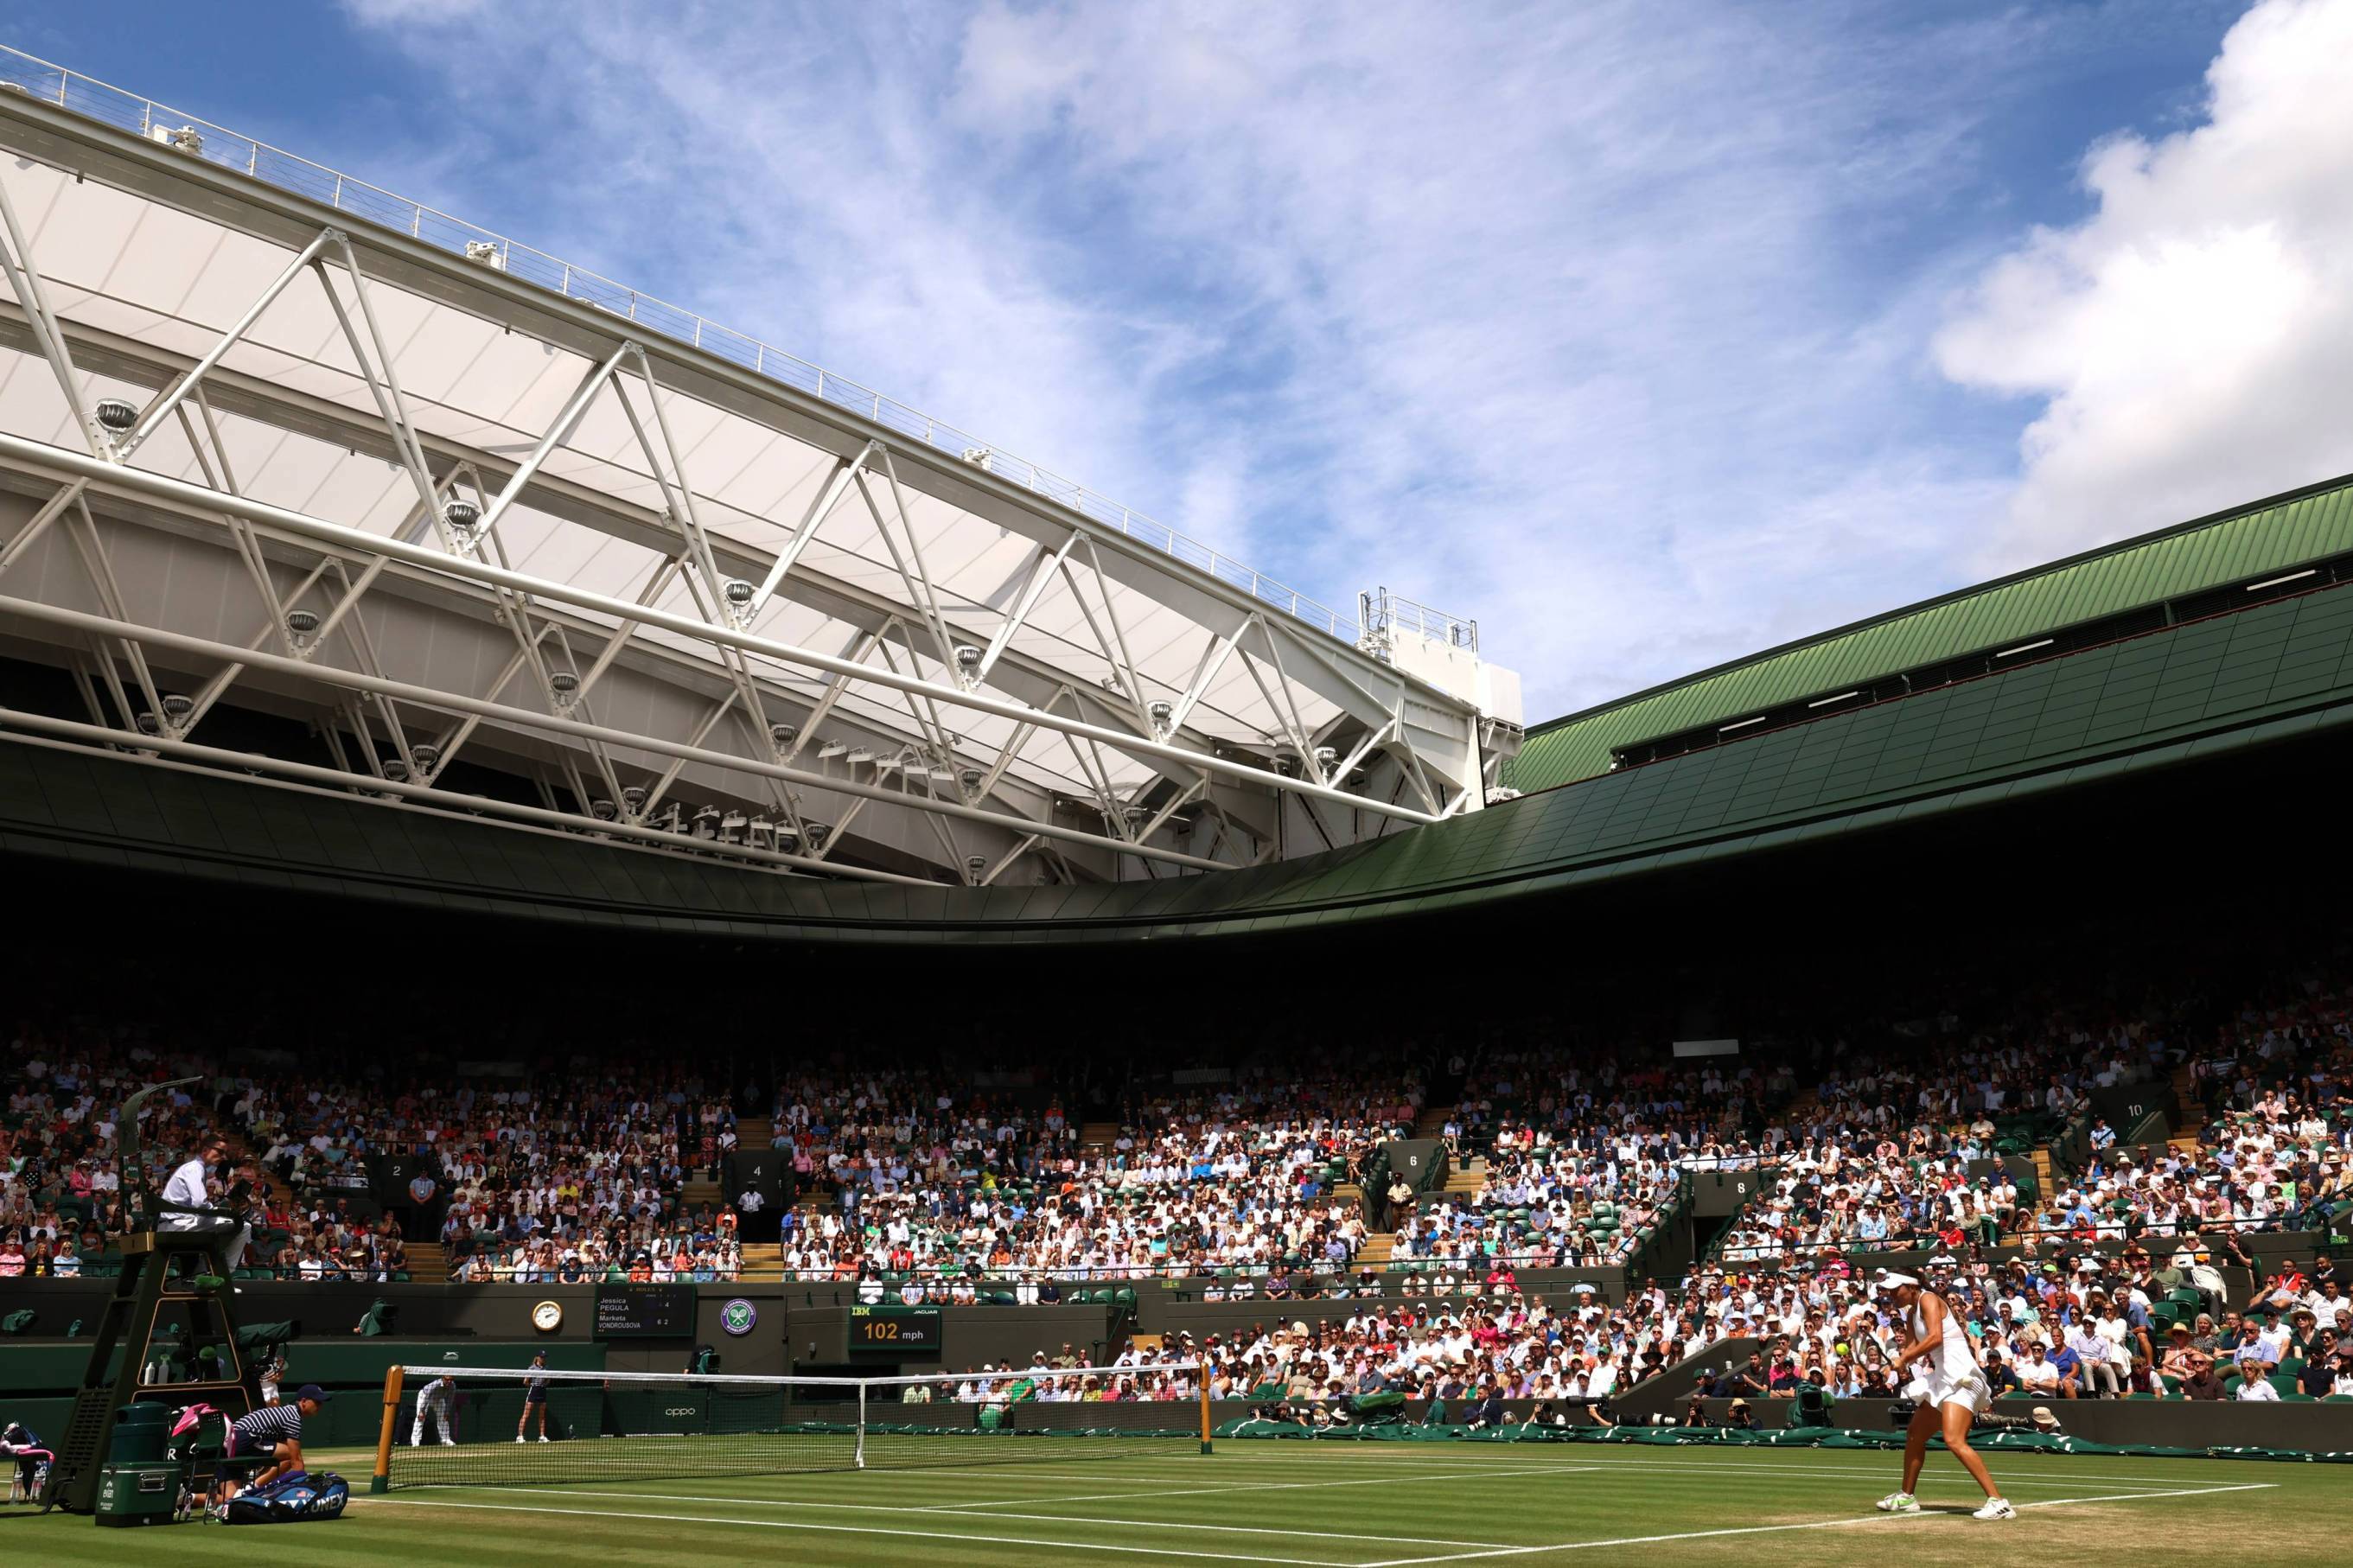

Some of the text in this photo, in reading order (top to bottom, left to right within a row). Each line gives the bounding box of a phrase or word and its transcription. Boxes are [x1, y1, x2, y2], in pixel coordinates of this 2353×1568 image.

[2128, 1105, 2142, 1117] 10
[1410, 1156, 1418, 1166] 6
[393, 1165, 401, 1176] 2
[754, 1166, 761, 1176] 4
[1738, 1182, 1745, 1193] 8
[851, 1307, 870, 1316] IBM
[864, 1323, 923, 1342] 102 mph
[665, 1407, 696, 1418] oppo
